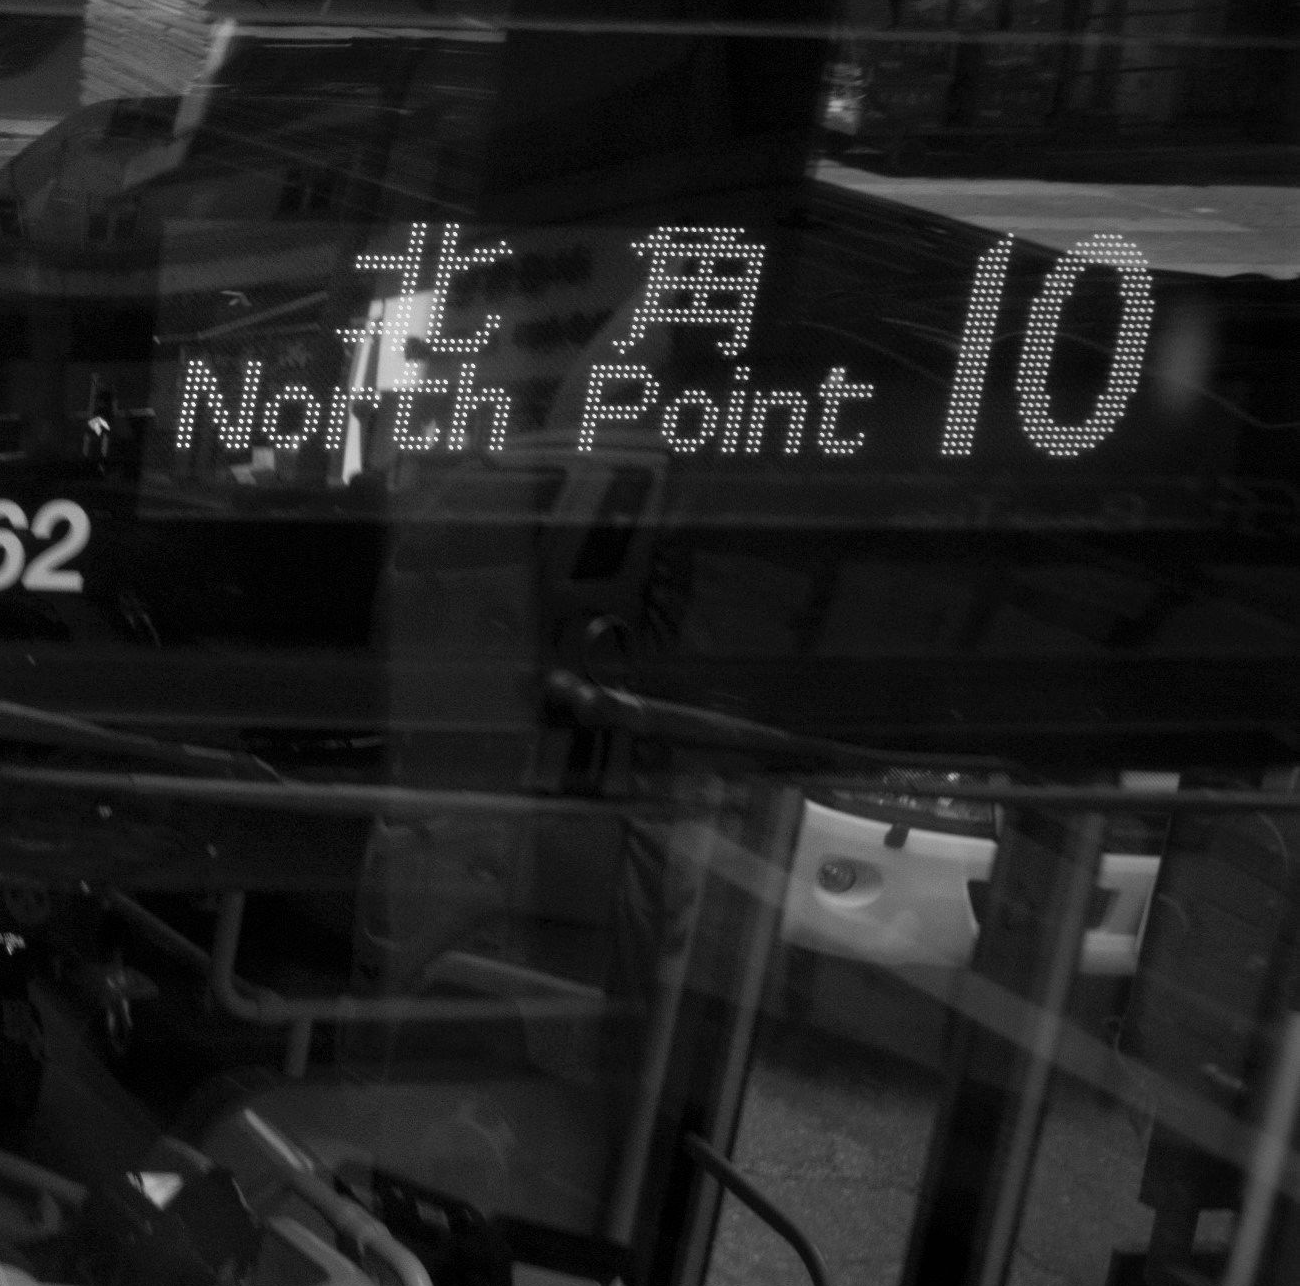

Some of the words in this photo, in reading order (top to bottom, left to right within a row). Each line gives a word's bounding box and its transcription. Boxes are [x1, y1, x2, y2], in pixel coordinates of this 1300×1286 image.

[335, 221, 767, 357] 北角
[937, 231, 1160, 459] 10
[172, 357, 515, 454] North
[577, 364, 877, 459] Point
